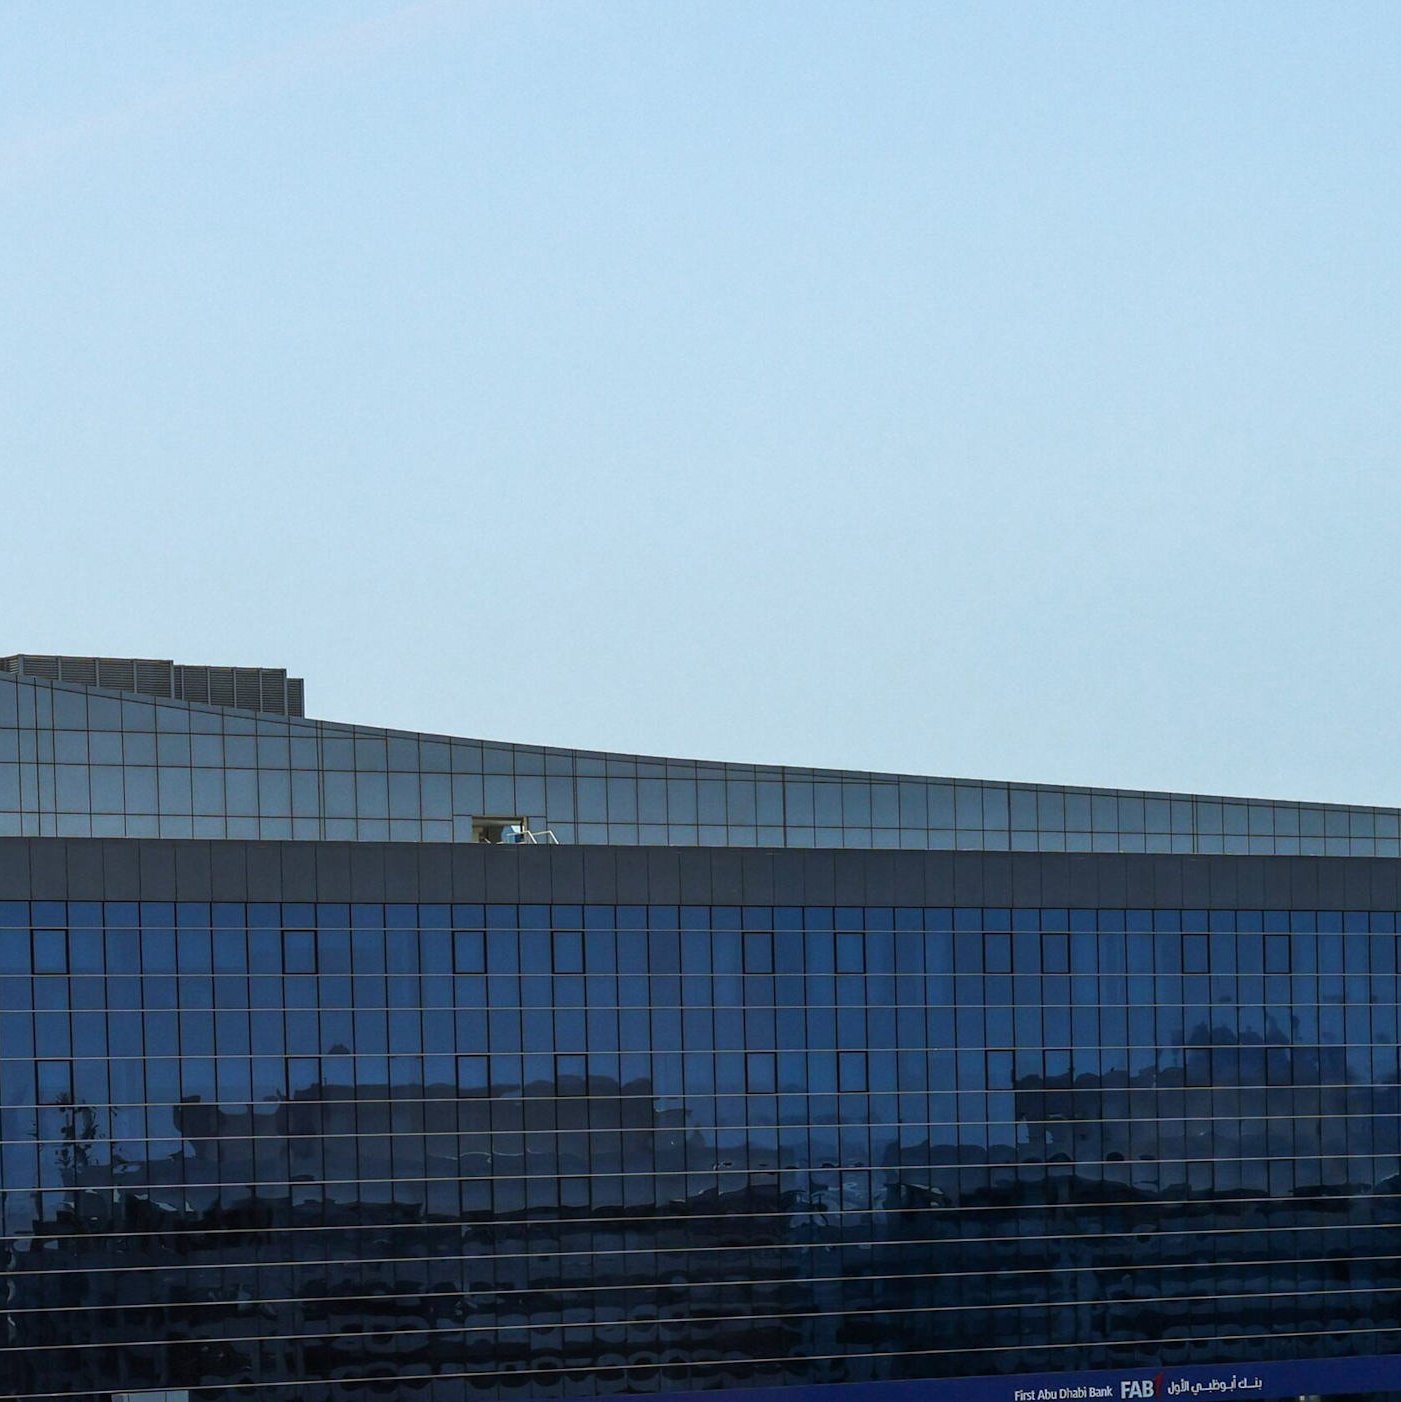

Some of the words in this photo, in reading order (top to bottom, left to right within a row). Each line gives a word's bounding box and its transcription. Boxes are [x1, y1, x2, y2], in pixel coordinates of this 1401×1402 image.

[1120, 1380, 1154, 1399] FAB
[1167, 1378, 1190, 1395] الأول
[1191, 1374, 1236, 1396] أبوظبي
[1238, 1377, 1263, 1391] بنك
[1014, 1389, 1035, 1401] First
[1037, 1388, 1057, 1401] Abu
[1059, 1386, 1087, 1399] Dhabi
[1089, 1385, 1113, 1398] Bank
